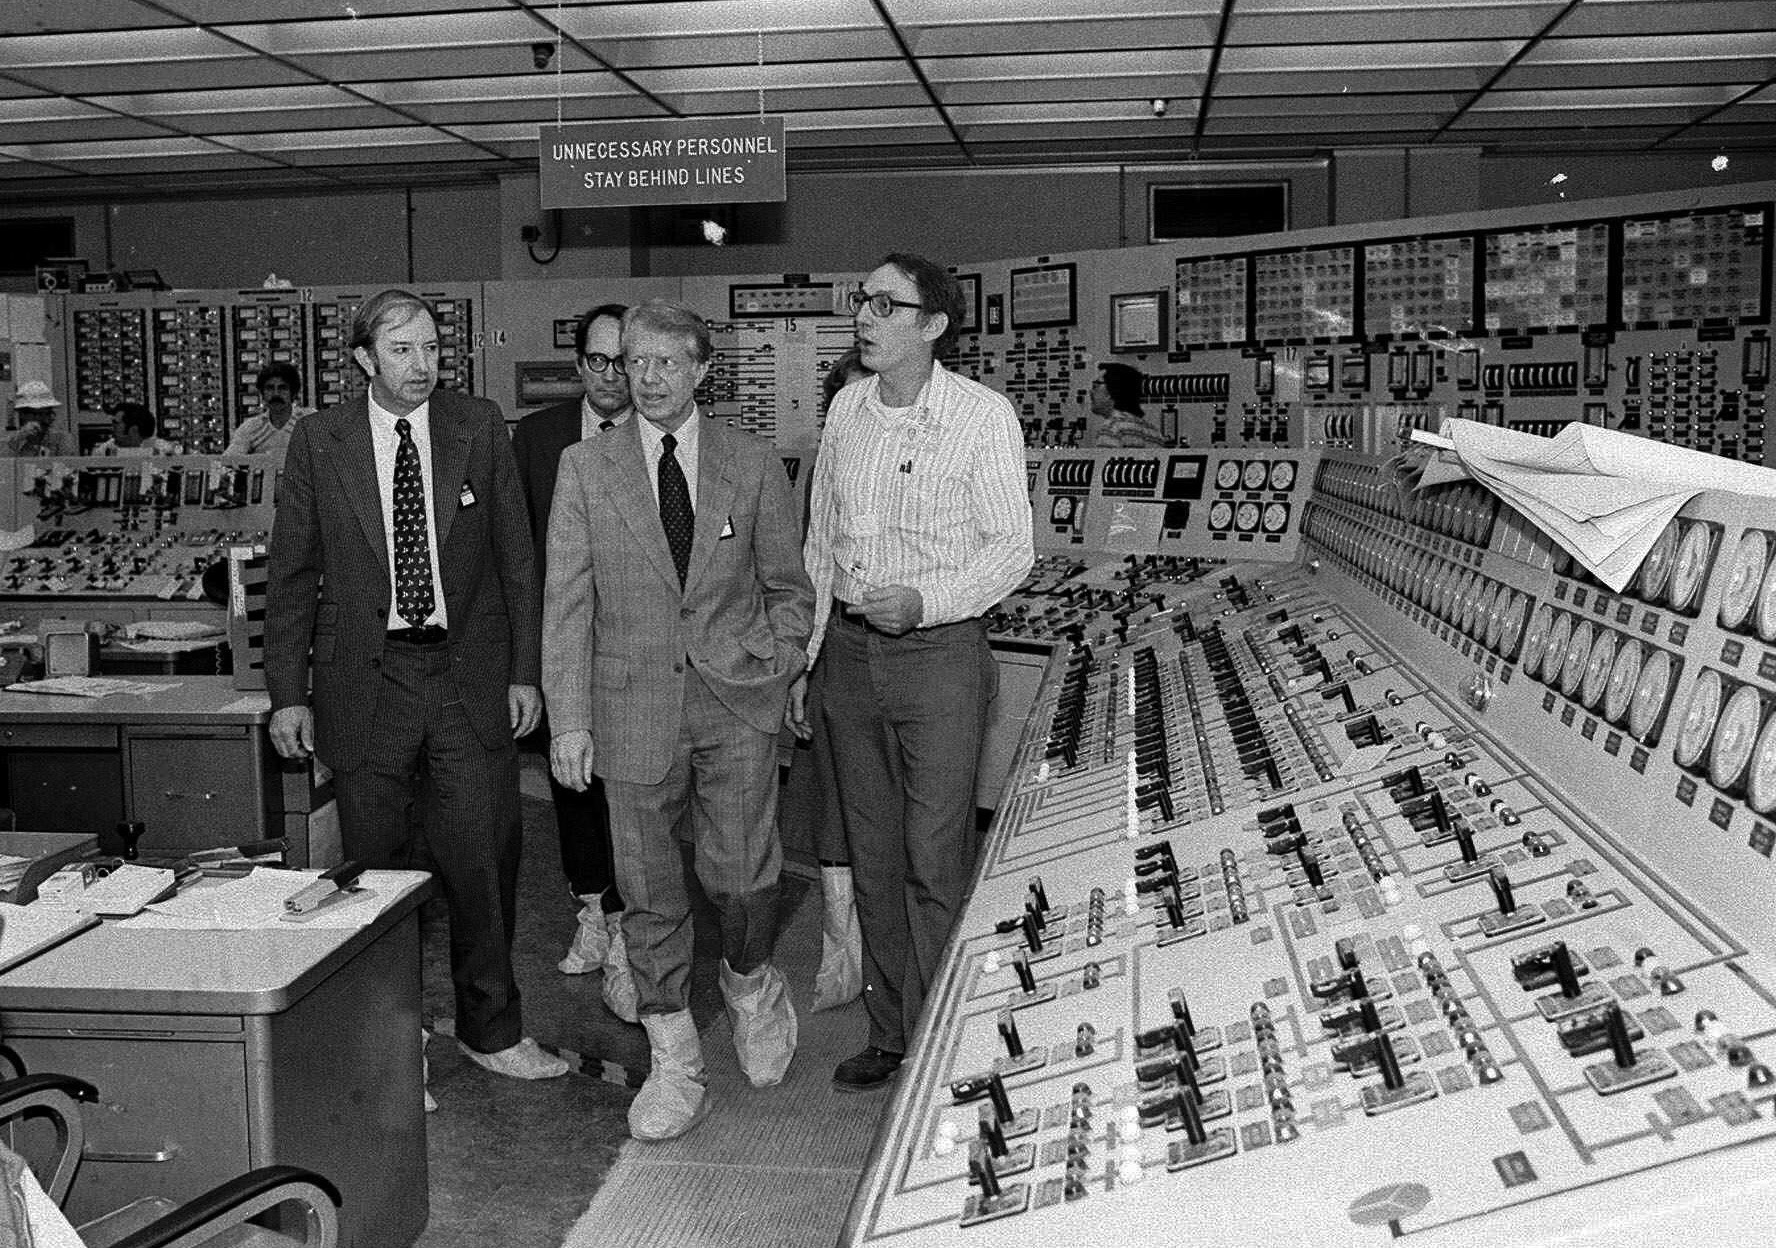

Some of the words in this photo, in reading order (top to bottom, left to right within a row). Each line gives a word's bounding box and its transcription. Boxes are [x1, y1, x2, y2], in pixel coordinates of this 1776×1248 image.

[552, 140, 672, 161] UNNECESSARY
[677, 136, 778, 156] PERSONNEL
[583, 172, 624, 188] STAY
[628, 168, 689, 187] BEHIND
[695, 166, 745, 184] LINES
[784, 317, 797, 332] 15
[494, 331, 505, 345] 14
[1286, 347, 1297, 361] 17
